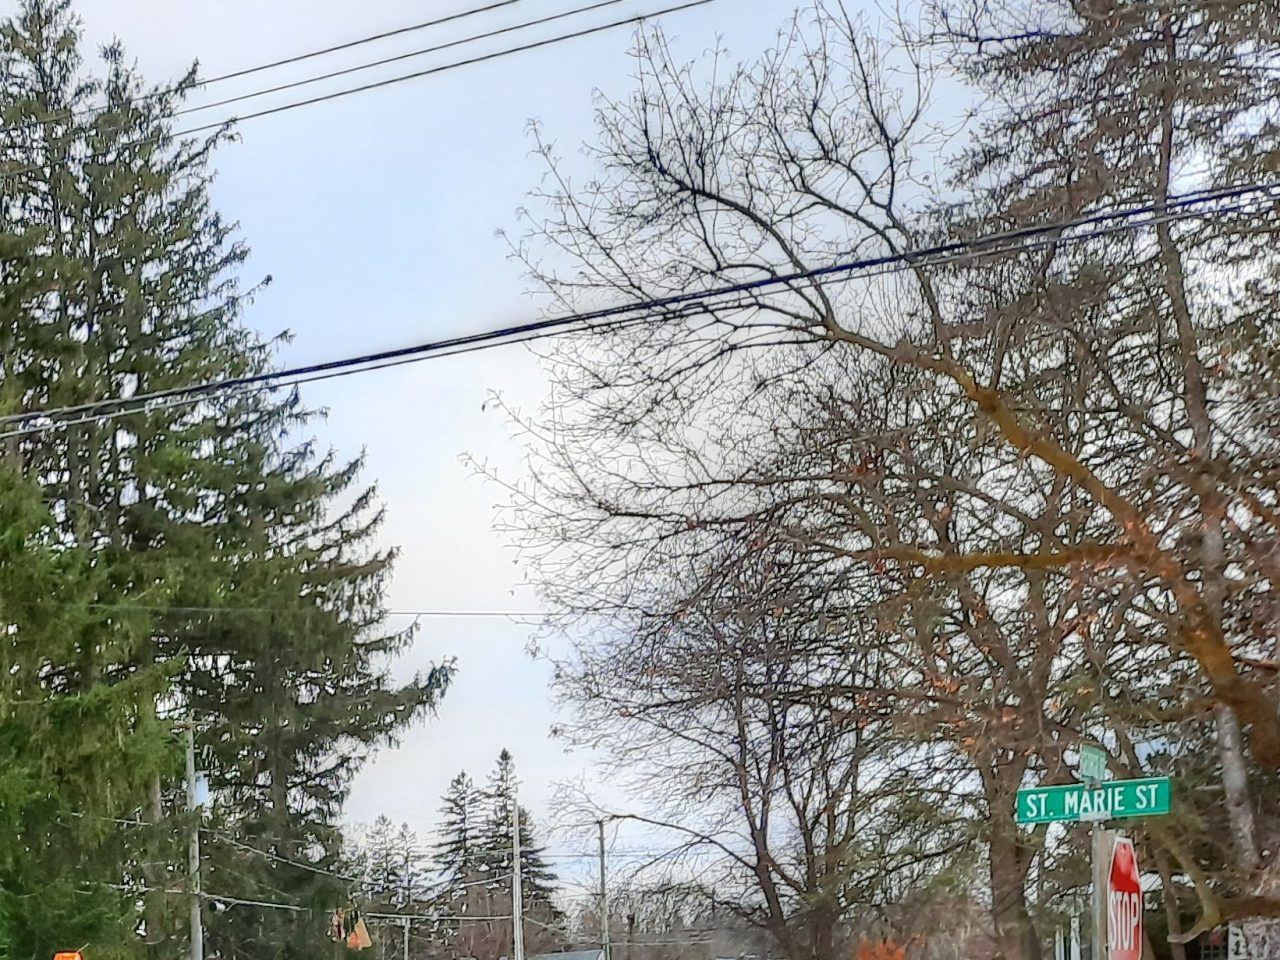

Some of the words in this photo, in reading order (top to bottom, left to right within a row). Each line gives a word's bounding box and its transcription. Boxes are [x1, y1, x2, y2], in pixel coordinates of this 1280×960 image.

[1026, 793, 1054, 818] ST.
[1064, 786, 1126, 815] MARIE
[1135, 784, 1159, 809] ST
[1109, 891, 1139, 950] STOP
